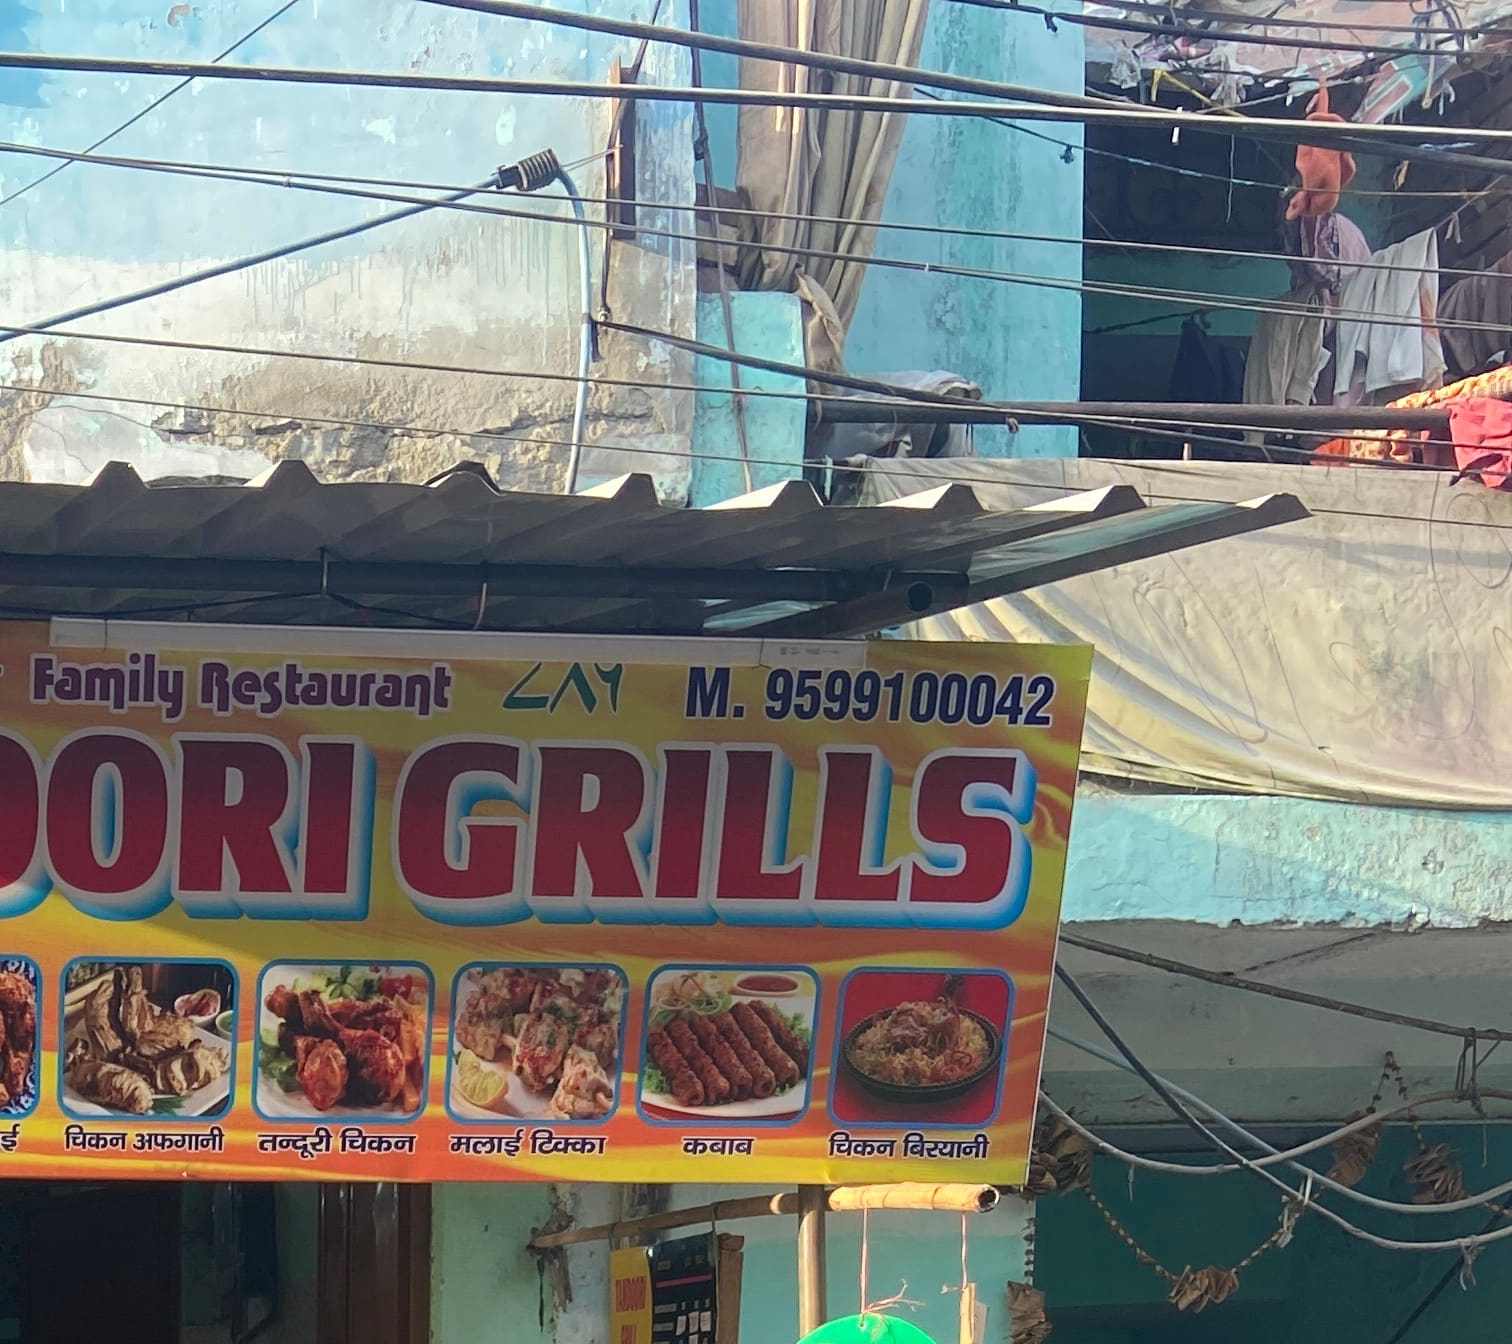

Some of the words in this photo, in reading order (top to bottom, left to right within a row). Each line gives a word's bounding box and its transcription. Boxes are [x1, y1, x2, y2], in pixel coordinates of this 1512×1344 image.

[33, 653, 184, 720] Family
[202, 662, 452, 717] Restaurant
[687, 667, 745, 719] M.
[765, 669, 1055, 726] 9599100042
[394, 738, 1028, 912] GRILLS
[65, 1124, 128, 1151] चिकन
[257, 1127, 334, 1158] तन्दूरी
[340, 1127, 416, 1154] चिकन
[449, 1128, 525, 1156] मलाई
[530, 1129, 606, 1156] टिक्का
[682, 1135, 753, 1157] कबाब
[828, 1132, 892, 1159] चिकन
[902, 1133, 990, 1160] बिरयानी
